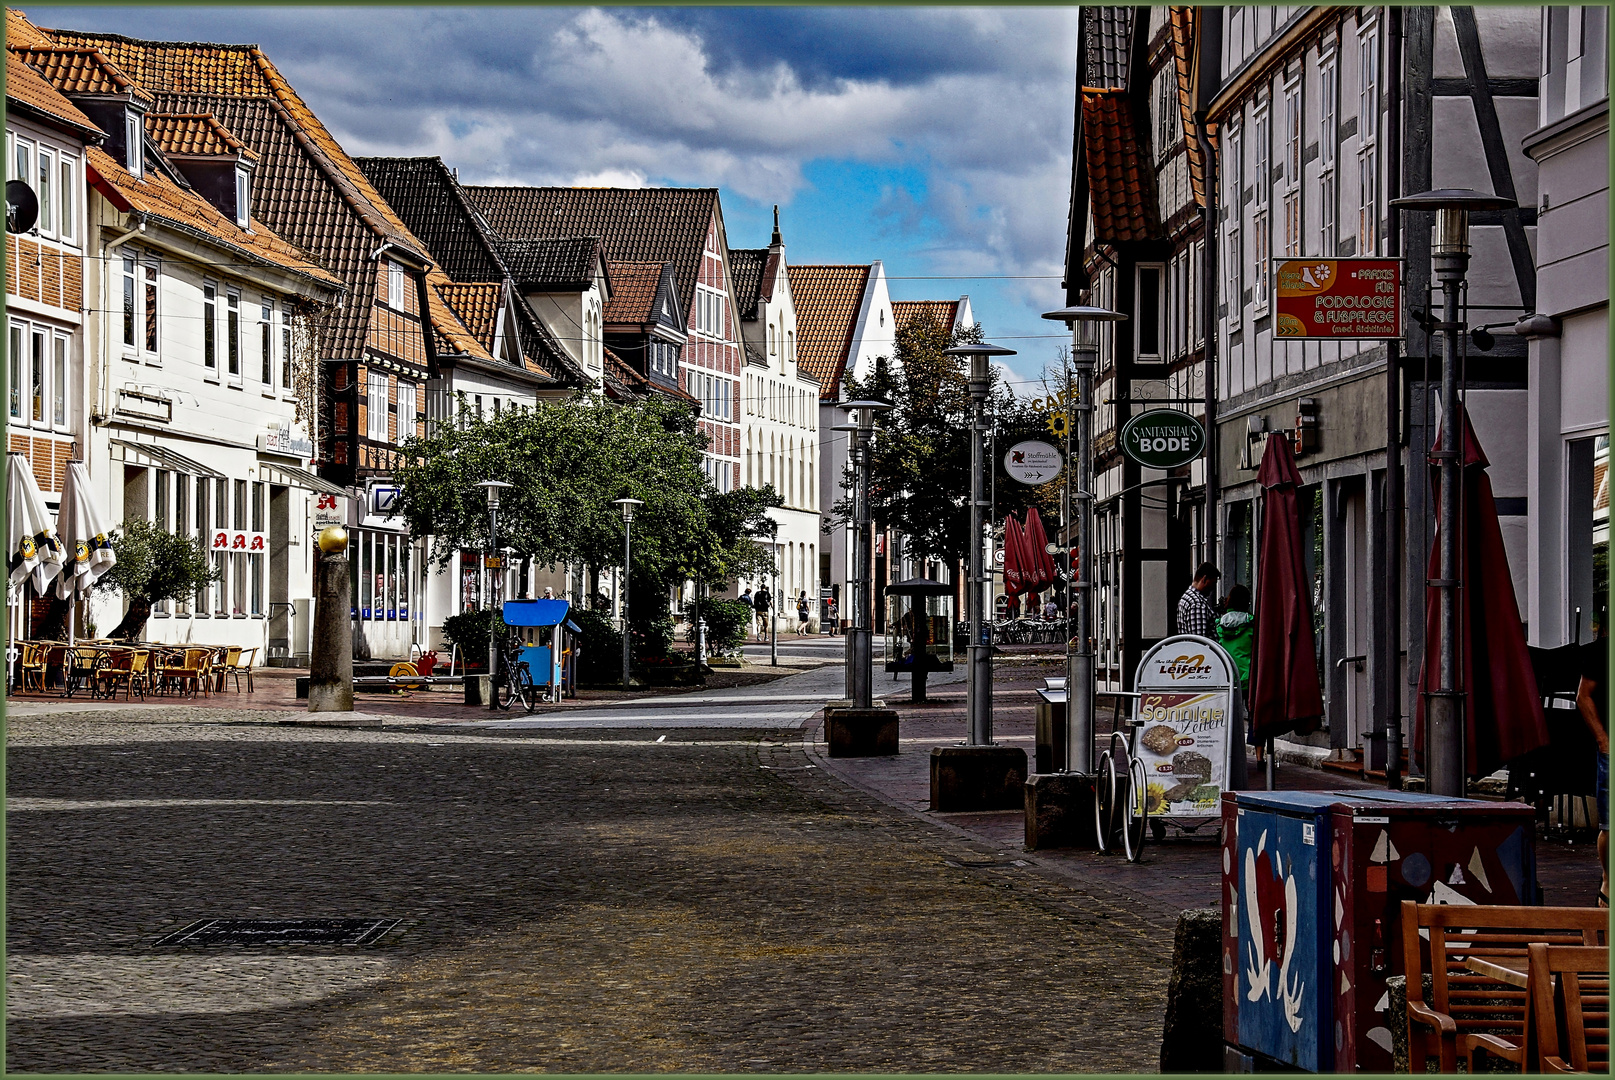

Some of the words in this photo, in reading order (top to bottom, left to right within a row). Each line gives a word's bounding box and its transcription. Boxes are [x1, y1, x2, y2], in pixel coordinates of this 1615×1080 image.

[1280, 271, 1301, 280] Vera
[1358, 269, 1394, 280] PRAXIS
[1281, 280, 1306, 289] Klaus
[1375, 281, 1394, 293] FÜR
[1315, 295, 1395, 309] PODOLOGIE
[1314, 310, 1325, 324] &
[1332, 324, 1355, 334] (med.
[1140, 437, 1190, 453] BODE
[1159, 664, 1212, 674] Leifert
[1143, 704, 1225, 723] Sonnige
[1176, 716, 1226, 736] Zeiten
